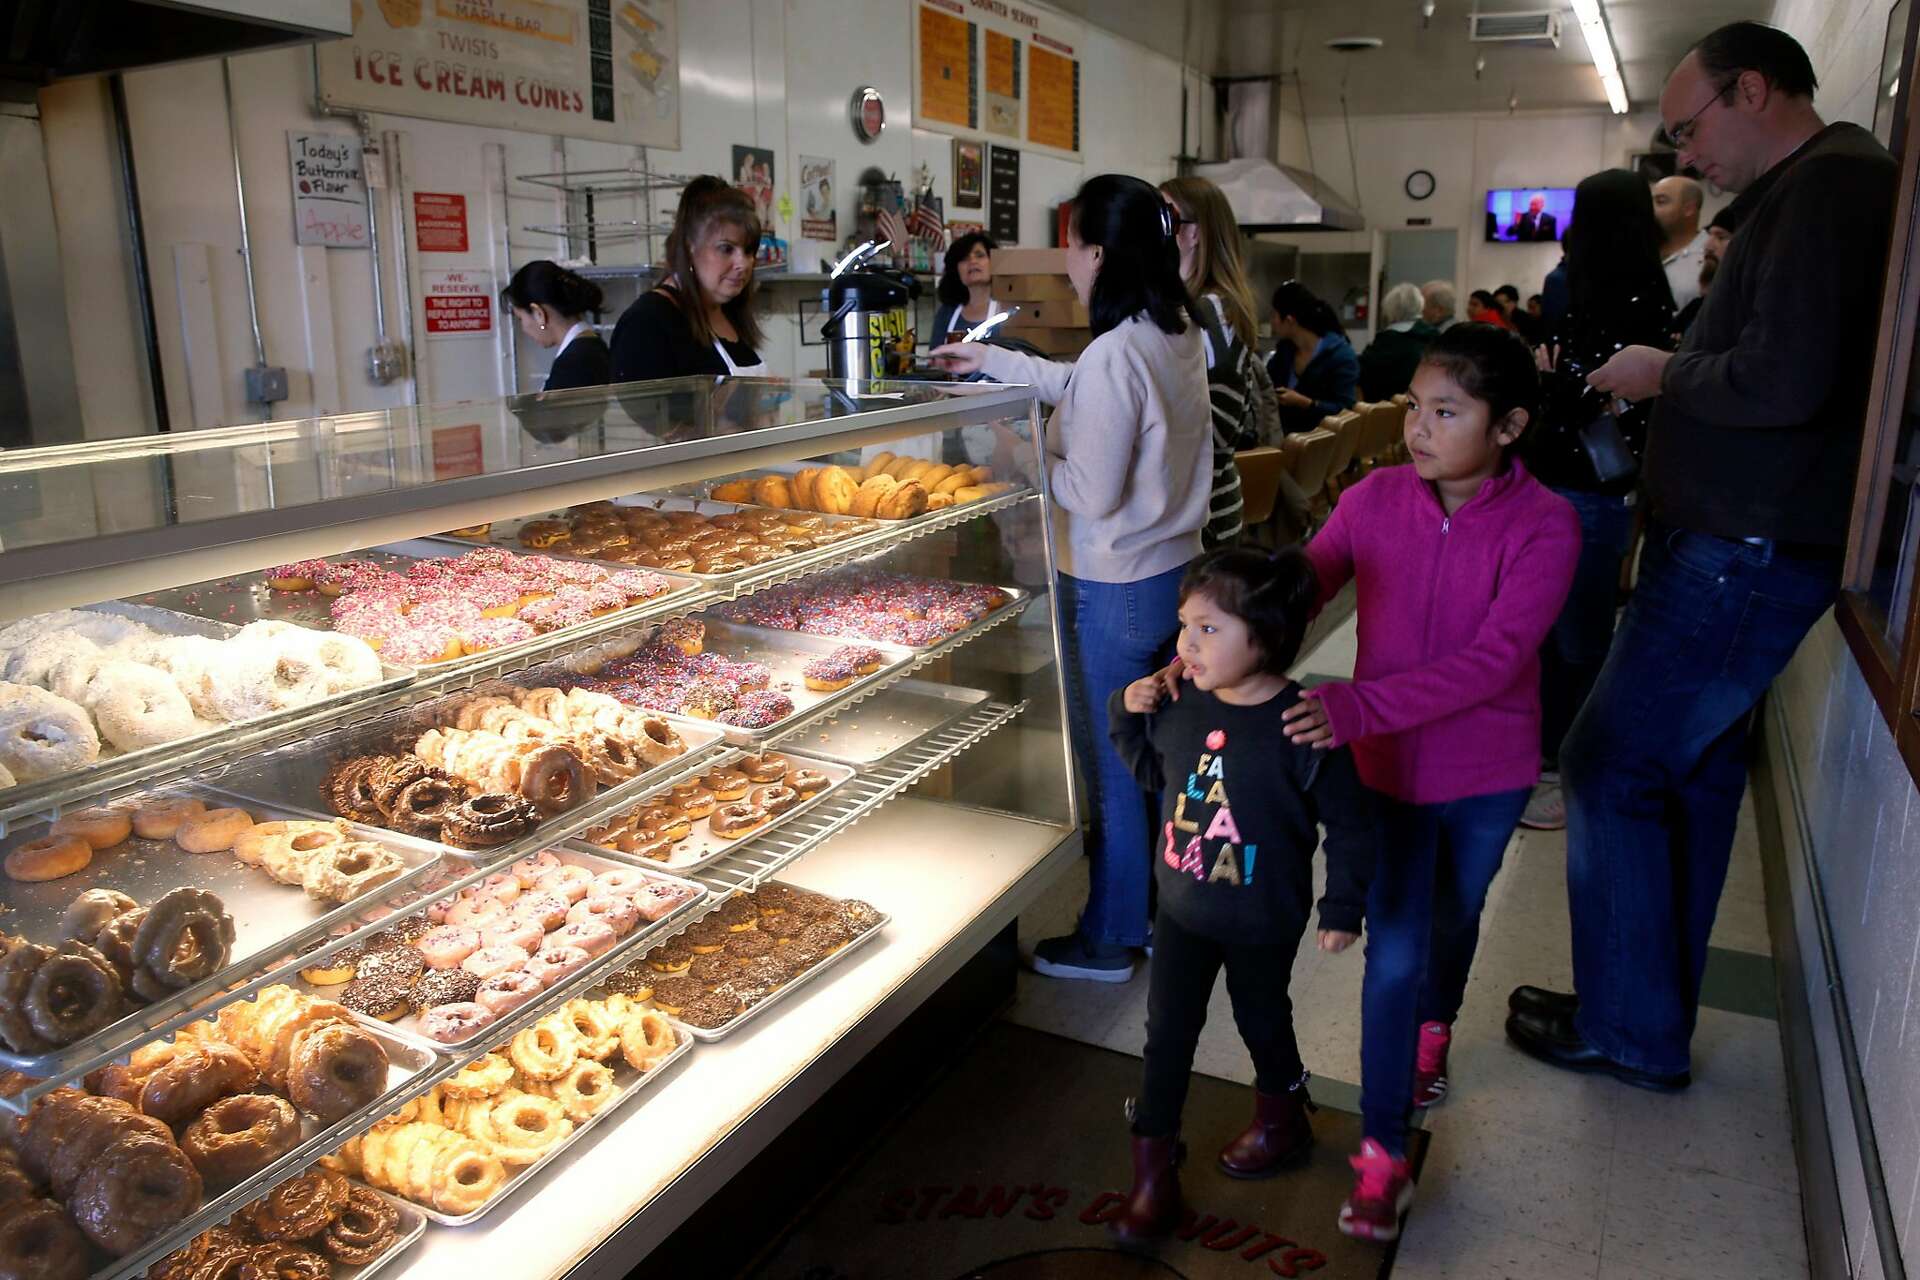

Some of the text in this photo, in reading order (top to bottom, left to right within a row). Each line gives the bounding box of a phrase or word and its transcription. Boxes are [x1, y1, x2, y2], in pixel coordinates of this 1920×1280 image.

[456, 3, 541, 32] MAPLE BAR
[438, 31, 498, 60] TWISTS
[352, 46, 584, 113] ICE CREAM CONES
[297, 136, 350, 168] Today's
[305, 208, 364, 242] Apple
[431, 284, 481, 293] RESERVE
[432, 298, 448, 307] THE
[471, 298, 483, 307] TO
[427, 309, 489, 319] REFUSE SERVICE
[438, 320, 481, 329] TO ANYONE
[1197, 753, 1225, 779] FA
[1186, 773, 1230, 804] LA
[1174, 792, 1242, 844] LA
[873, 1184, 1327, 1278] STAN'S DNUTS
